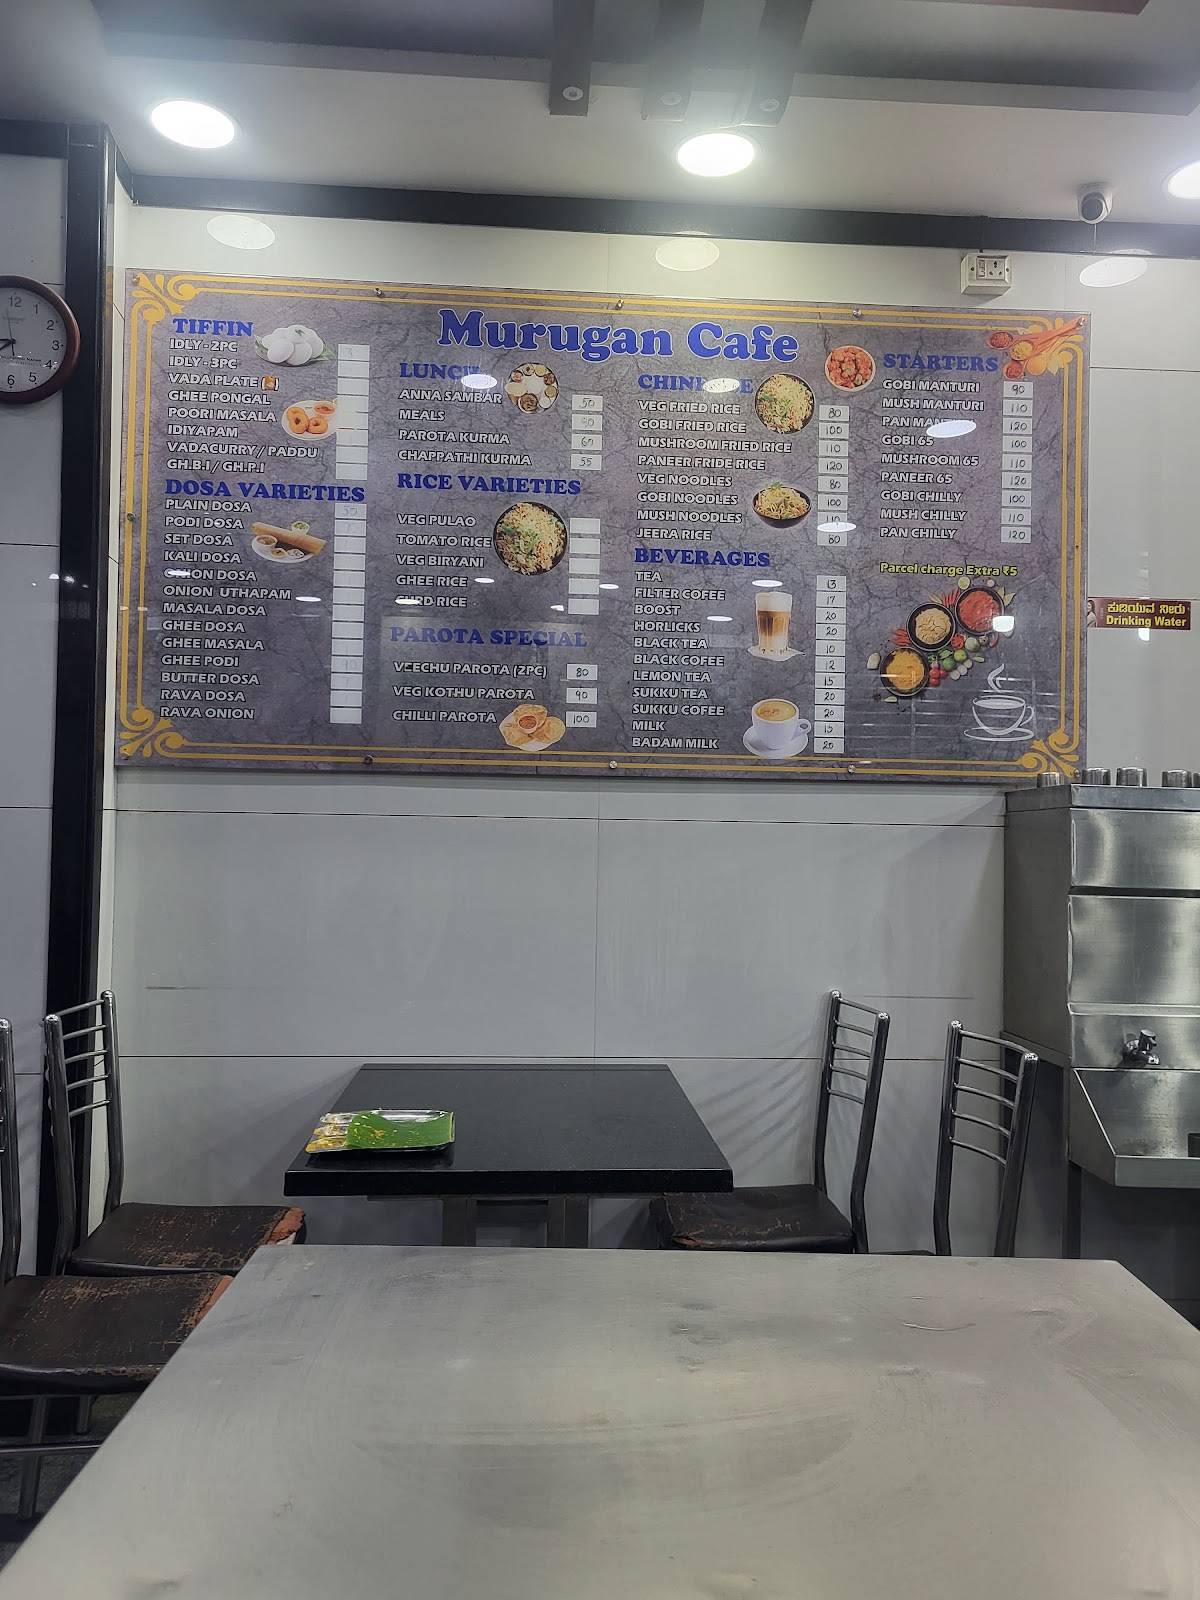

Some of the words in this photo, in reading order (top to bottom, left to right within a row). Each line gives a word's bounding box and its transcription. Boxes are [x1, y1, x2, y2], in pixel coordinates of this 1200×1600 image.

[9, 296, 22, 307] 12
[46, 320, 54, 330] 2
[173, 318, 253, 336] TIFFIN
[438, 309, 674, 363] Murugan
[687, 321, 799, 362] Cafe
[52, 340, 60, 350] 3
[45, 360, 52, 369] 4
[883, 353, 998, 372] STARTERS
[8, 375, 15, 385] 6
[29, 372, 37, 382] 5
[168, 374, 211, 385] VADA
[214, 375, 258, 386] PLATE
[883, 380, 916, 390] GOBI
[919, 380, 980, 392] MANTURI
[1012, 385, 1025, 394] 90
[168, 391, 208, 402] GHEE
[211, 393, 270, 404] PONGAL
[399, 390, 442, 400] ANNA
[444, 391, 502, 403] SAMBAR
[639, 401, 667, 412] VEG
[669, 402, 709, 413] FRIED
[711, 403, 740, 414] RICE
[882, 398, 919, 409] MUSH
[922, 399, 984, 411] MANTURI
[168, 408, 214, 419] POORI
[217, 410, 277, 422] MASALA
[399, 410, 445, 421] MEALS
[829, 408, 841, 417] 80
[639, 419, 672, 430] GOBI
[675, 420, 714, 432] FRIED
[716, 422, 746, 433] RICE
[882, 416, 910, 426] PAN
[168, 424, 238, 437] IDIYAPAM
[399, 430, 456, 442] PAROTA
[459, 432, 510, 444] KURMA
[882, 436, 915, 445] GOBI
[917, 436, 934, 446] 65
[638, 437, 718, 450] MUSHROOM
[721, 440, 760, 452] FRIED
[762, 441, 792, 453] RICE
[1012, 440, 1026, 448] 100
[399, 451, 478, 463] CHAPPATHI
[480, 453, 532, 465] KURMA
[638, 456, 692, 467] PANEER
[695, 457, 733, 469] FRIDE
[736, 459, 765, 470] RICE
[881, 453, 960, 466] MUSHROOM
[963, 456, 979, 466] 65
[826, 462, 842, 470] 120
[398, 473, 452, 488] RICE
[458, 476, 581, 494] VARIETIES
[638, 474, 665, 484] VEG
[668, 474, 732, 486] NOODLES
[881, 472, 933, 483] PANEER
[936, 474, 952, 484] 65
[165, 479, 231, 497] DOSA
[239, 483, 365, 501] VARIETIES
[830, 480, 841, 489] 80
[638, 491, 671, 502] GOBI
[674, 493, 738, 505] NOODLES
[827, 498, 841, 506] 100
[881, 490, 914, 501] GOBI
[917, 492, 962, 502] CHILLY
[1009, 495, 1025, 503] 100
[166, 499, 208, 511] PLAIN
[211, 501, 252, 512] DOSA
[398, 514, 426, 525] VEG
[428, 516, 476, 526] PULAO
[637, 510, 676, 521] MUSH
[678, 511, 742, 523] NOODLES
[880, 508, 918, 520] MUSH
[921, 510, 967, 521] CHILLY
[165, 517, 199, 528] PODI
[204, 518, 243, 529] DOSA
[637, 529, 679, 540] JEERA
[682, 530, 711, 540] RICE
[880, 527, 908, 537] PAN
[911, 528, 956, 539] CHILLY
[1008, 531, 1025, 540] 120
[164, 534, 190, 545] SET
[193, 535, 233, 546] DOSA
[397, 535, 458, 546] TOMATO
[461, 536, 491, 547] RICE
[164, 551, 197, 562] KALI
[201, 553, 241, 564] DOSA
[396, 554, 426, 565] VEG
[428, 556, 484, 568] BIRYANI
[635, 548, 770, 567] BEVERAGES
[217, 570, 256, 581] DOSA
[880, 563, 918, 573] Parcel
[920, 564, 964, 576] charge
[966, 566, 1000, 575] Extra
[1003, 566, 1017, 575] ₹5
[396, 576, 434, 586] GHEE
[437, 576, 467, 587] RICE
[636, 571, 662, 582] TEA
[827, 579, 836, 589] 13
[163, 586, 213, 597] ONION
[220, 588, 291, 600] UTHAPAM
[635, 588, 679, 599] FILTER
[682, 589, 725, 600] COFEE
[436, 597, 467, 607] RICE
[163, 603, 223, 614] MASALA
[226, 605, 266, 616] DOSA
[634, 605, 680, 615] BOOST
[162, 620, 201, 632] GHEE
[204, 622, 245, 633] DOSA
[634, 622, 700, 632] HORLICKS
[1106, 615, 1151, 627] Drinking
[1155, 616, 1186, 626] Water
[390, 627, 484, 644] PAROTA
[490, 630, 587, 647] SPECIAL
[827, 627, 837, 636] 20
[162, 638, 200, 649] GHEE
[204, 639, 264, 651] MASALA
[634, 638, 679, 648] BLACK
[682, 639, 708, 649] TEA
[162, 656, 200, 666] GHEE
[204, 656, 239, 667] PODI
[634, 655, 679, 665] BLACK
[681, 656, 724, 666] COFEE
[453, 663, 510, 675] PAROTA
[513, 665, 547, 678] (2PC)
[576, 667, 588, 677] 80
[633, 671, 681, 682] LEMON
[684, 672, 711, 682] TEA
[161, 673, 216, 684] BUTTER
[220, 674, 259, 685] DOSA
[161, 690, 202, 701] RAVA
[205, 691, 245, 702] DOSA
[394, 686, 422, 697] VEG
[425, 687, 474, 698] KOTHU
[477, 688, 535, 700] PAROTA
[576, 691, 588, 700] 90
[632, 687, 679, 698] SUKKU
[682, 689, 708, 699] TEA
[824, 692, 835, 701] 20
[160, 707, 201, 718] RAVA
[205, 708, 254, 719] ONION
[632, 704, 679, 714] SUKKU
[681, 705, 725, 716] COFEE
[393, 711, 436, 721] CHILLI
[440, 712, 496, 723] PAROTA
[573, 714, 590, 724] 100
[632, 720, 667, 731] MILK
[632, 737, 682, 748] BADAM
[685, 738, 718, 748] MILK
